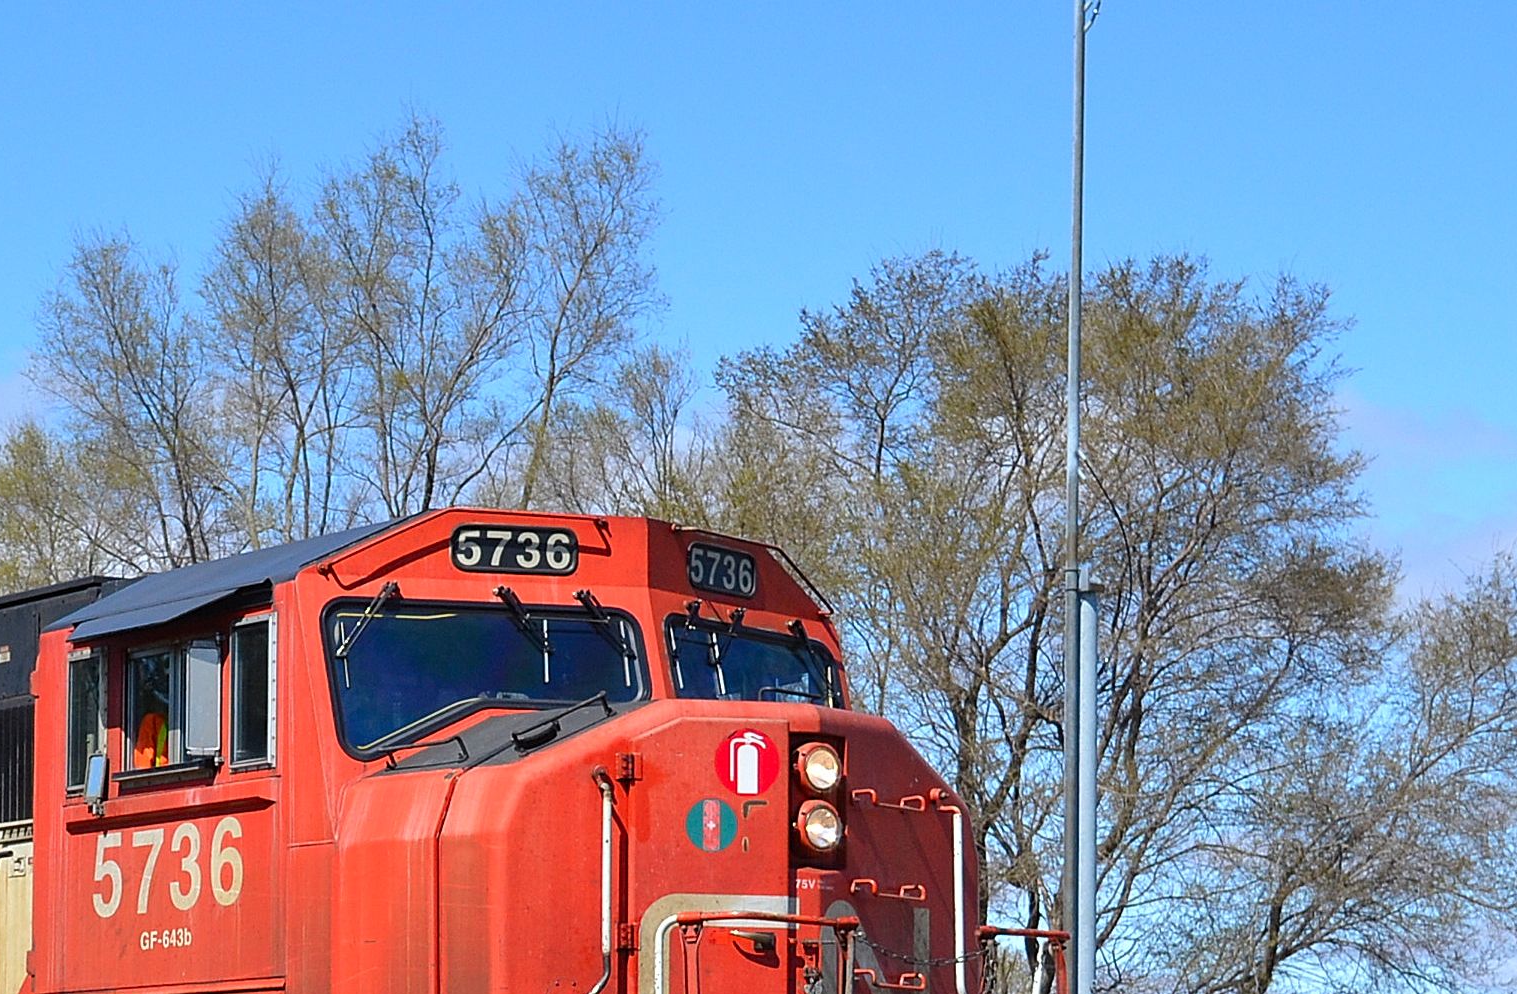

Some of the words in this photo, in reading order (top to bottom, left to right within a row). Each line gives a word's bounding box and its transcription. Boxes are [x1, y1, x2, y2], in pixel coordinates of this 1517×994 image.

[455, 529, 572, 570] 5736
[689, 547, 753, 595] 5736
[92, 816, 244, 919] 5736
[140, 927, 193, 951] GF-643b
